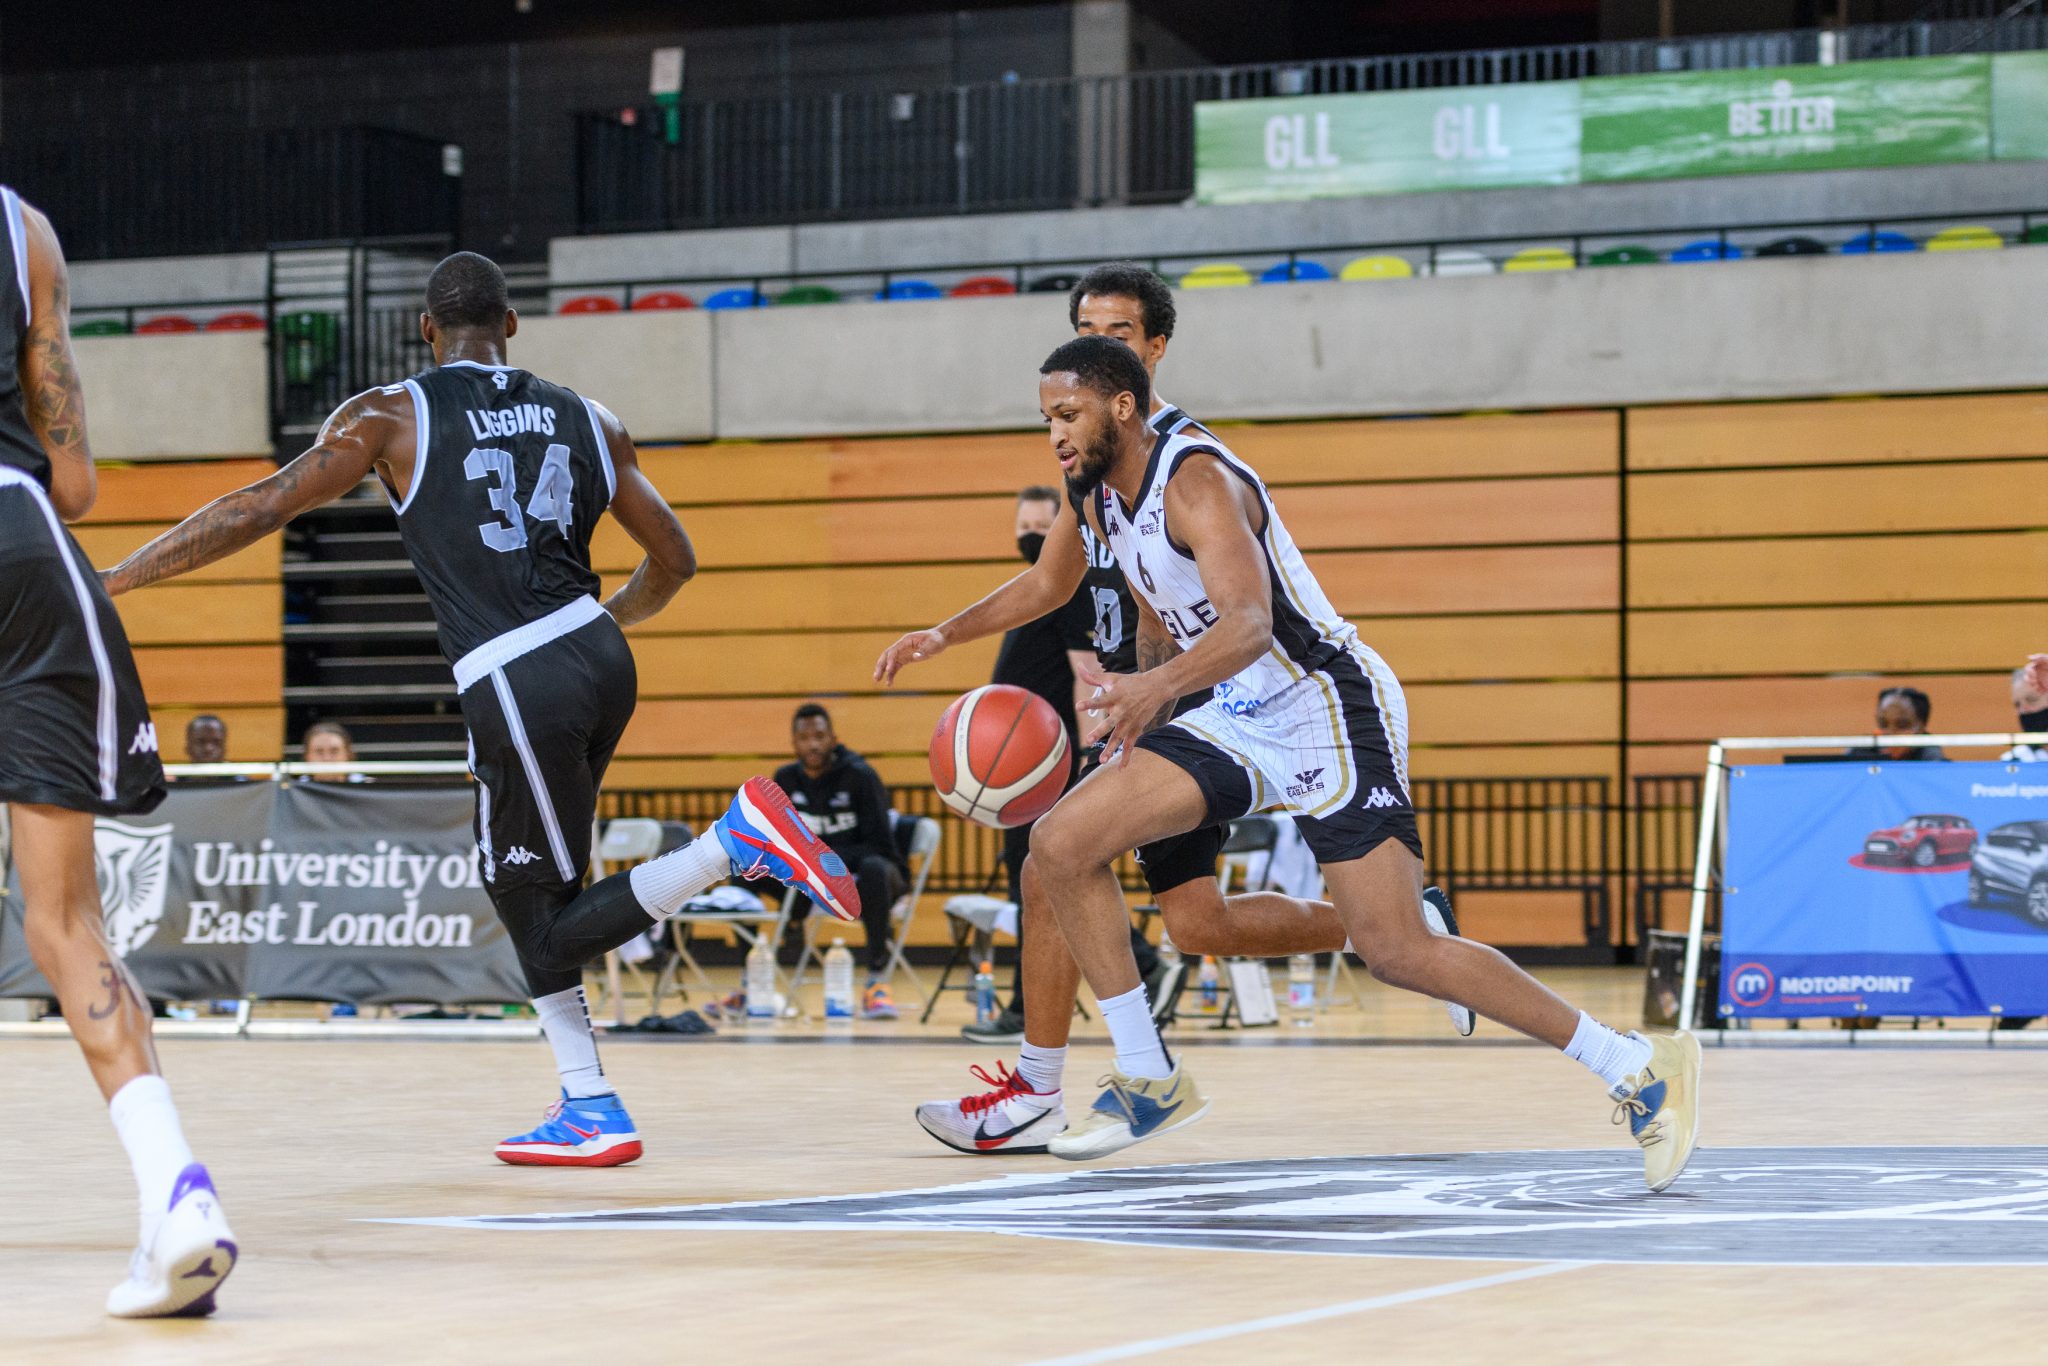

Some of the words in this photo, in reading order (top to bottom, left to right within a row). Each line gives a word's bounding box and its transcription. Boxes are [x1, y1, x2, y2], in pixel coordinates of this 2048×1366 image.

[1434, 102, 1511, 161] GLL
[1729, 97, 1835, 137] BETTER
[1264, 111, 1340, 170] GLL
[466, 403, 556, 441] LIGGINS
[463, 443, 574, 552] 34
[1137, 551, 1157, 595] 6
[1286, 781, 1325, 798] EAGLES
[1971, 782, 2018, 798] Proud
[193, 838, 438, 900] University
[182, 899, 289, 945] East
[293, 898, 473, 948] London
[1780, 974, 1914, 995] MOTORPOINT
